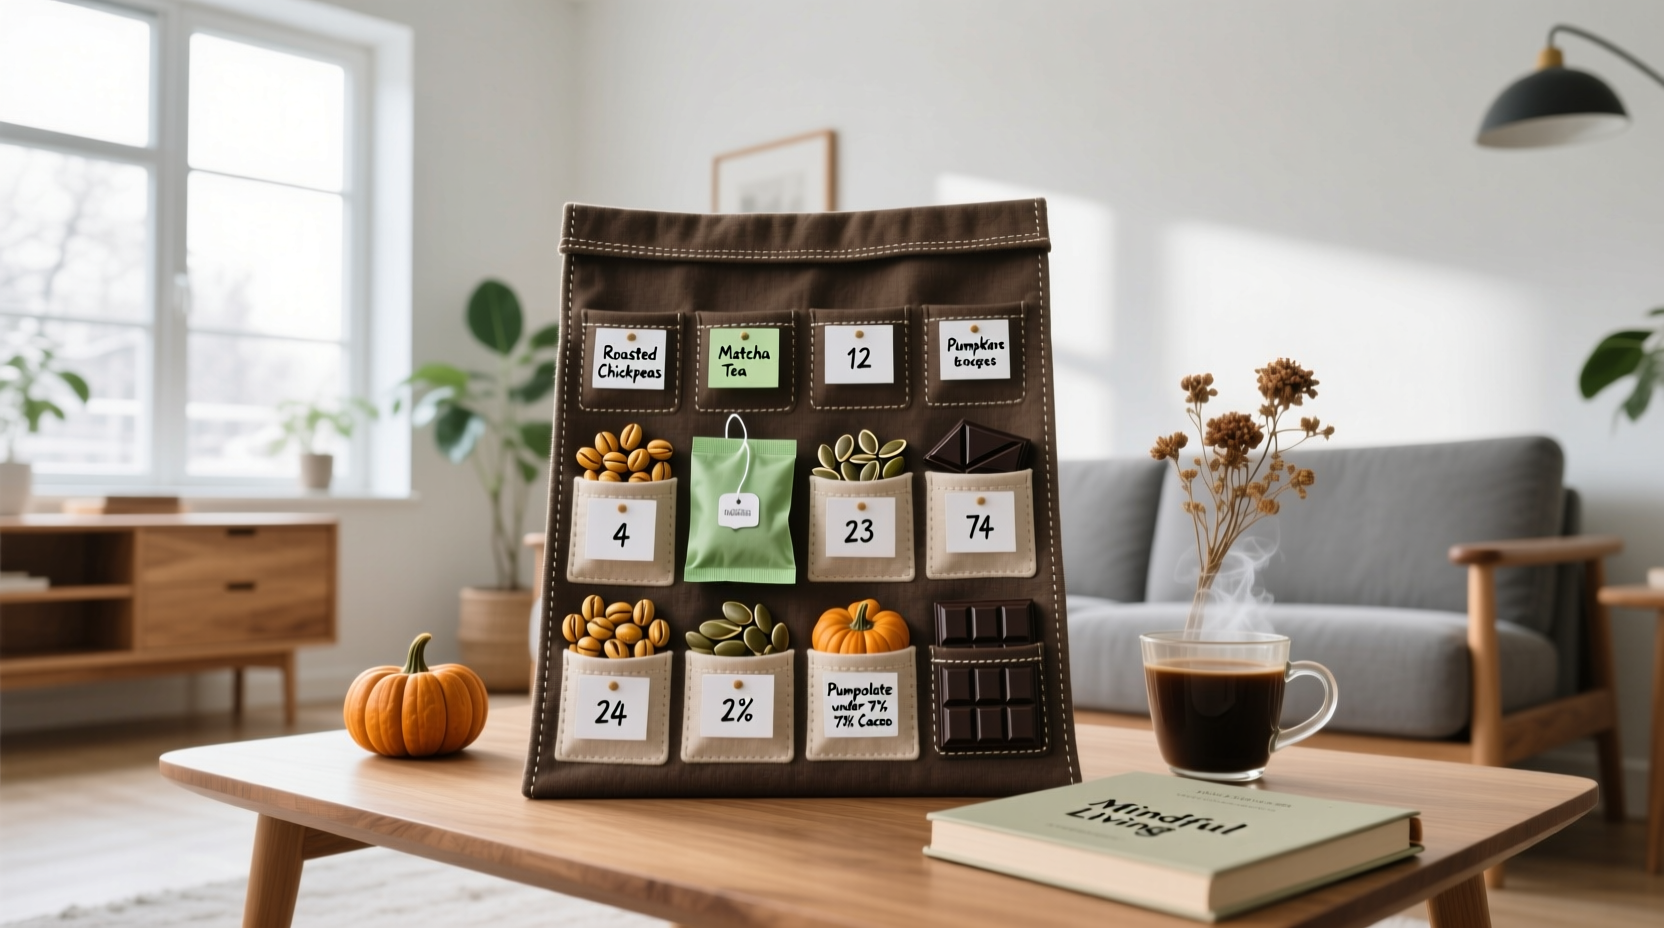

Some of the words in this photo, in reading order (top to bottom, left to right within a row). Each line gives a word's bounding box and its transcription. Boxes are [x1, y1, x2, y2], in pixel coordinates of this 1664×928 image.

[604, 345, 657, 360] Roasted
[719, 345, 770, 359] Matcha
[848, 347, 871, 369] 12
[598, 363, 661, 383] Chickpeas
[722, 363, 746, 377] Tea
[613, 523, 630, 547] 4
[845, 519, 873, 543] 23
[966, 515, 994, 539] 74
[827, 681, 893, 702] Pumpolate
[595, 700, 627, 726] 24
[721, 698, 753, 722] 2%
[1065, 806, 1176, 837] Living
[1088, 798, 1248, 835] Mindful
